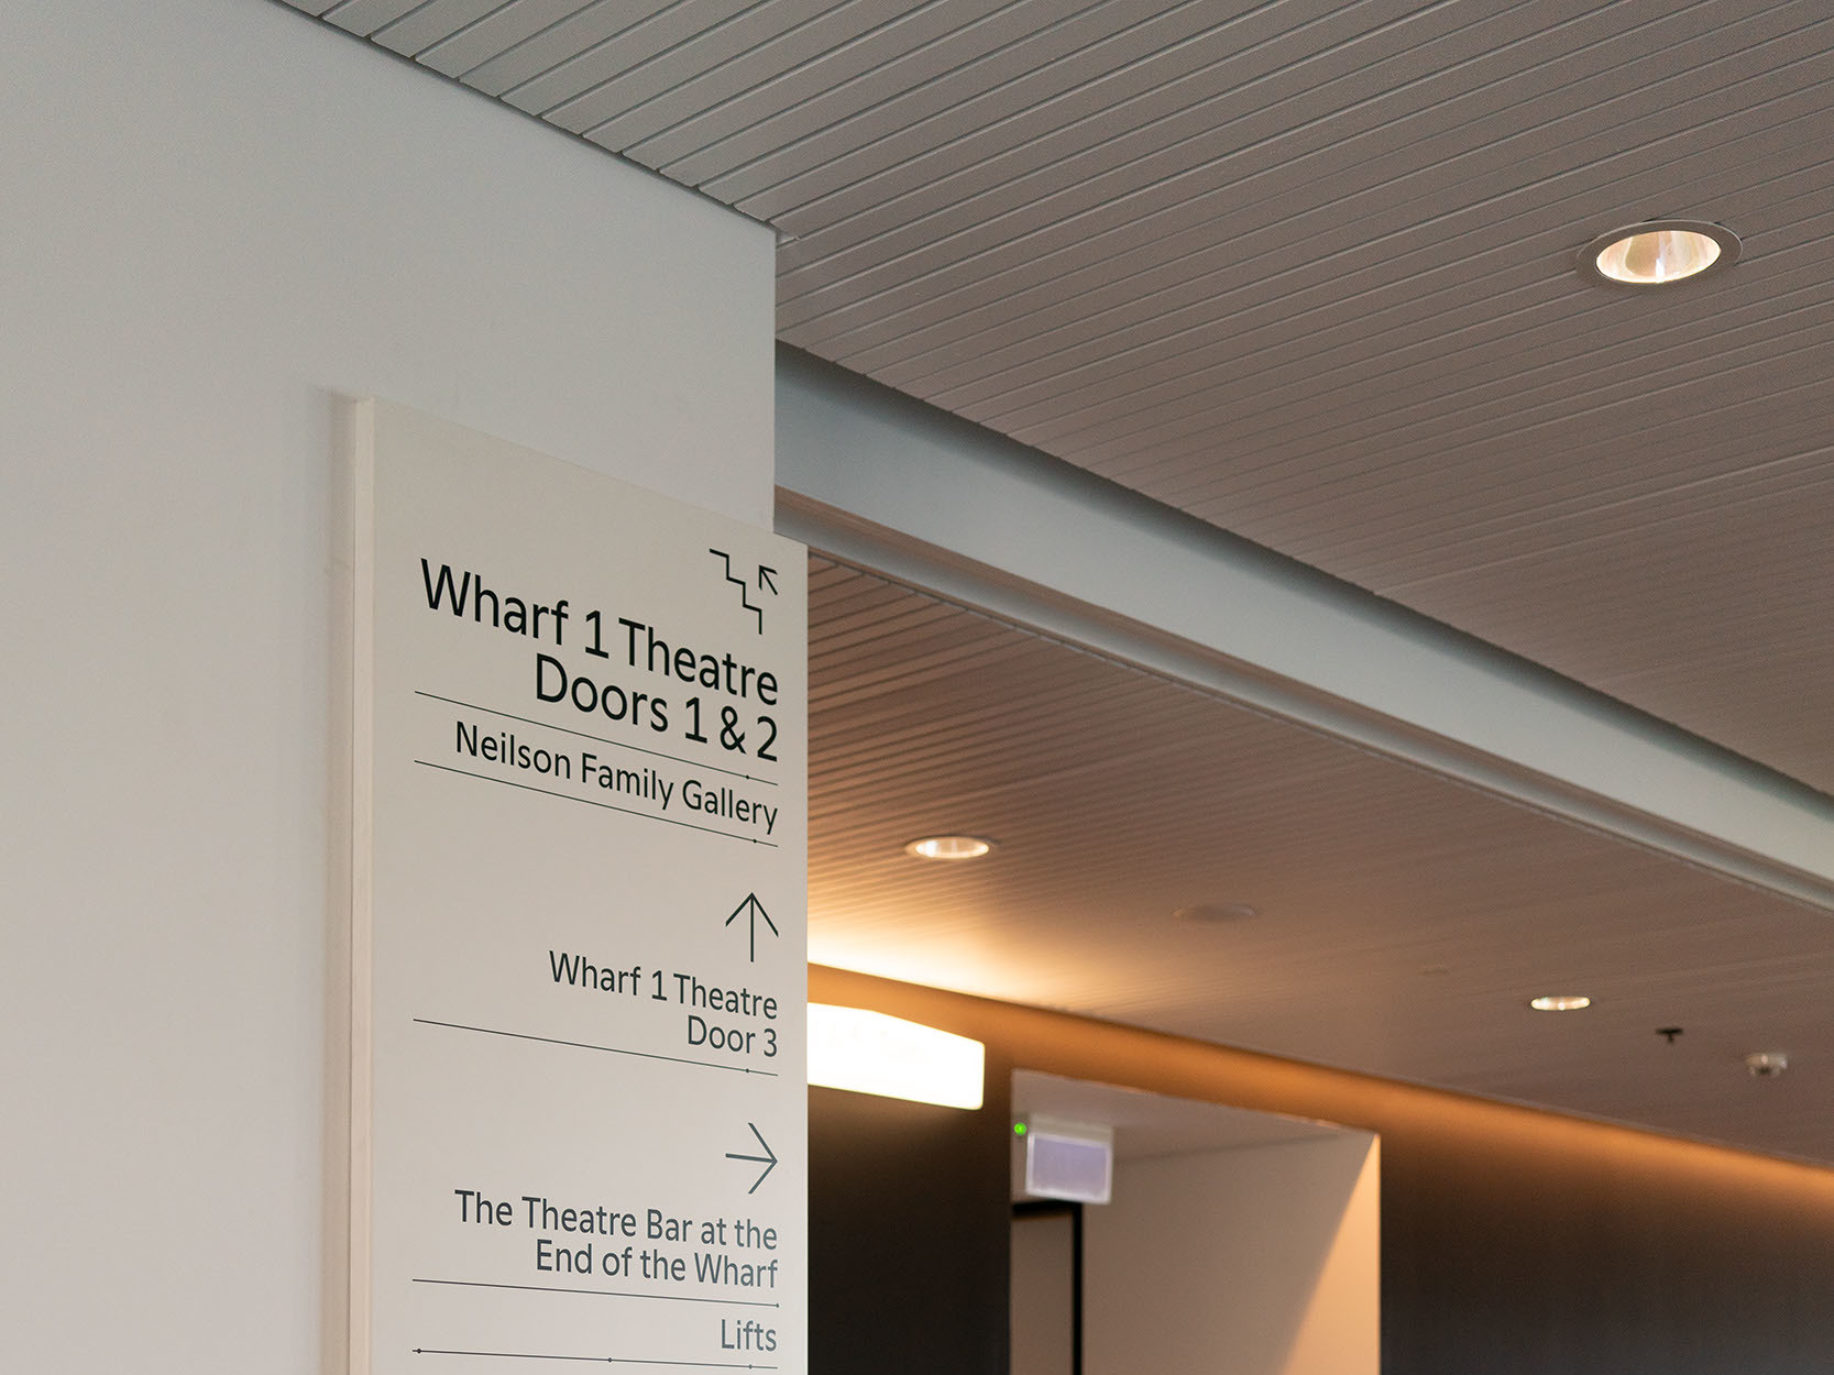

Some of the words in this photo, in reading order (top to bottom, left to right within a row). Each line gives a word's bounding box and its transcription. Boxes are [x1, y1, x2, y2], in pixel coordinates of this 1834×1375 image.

[420, 557, 569, 646] Wharf
[584, 609, 610, 660] 1
[618, 616, 779, 706] Theatre
[536, 652, 669, 733] Doors
[684, 696, 708, 745] 1
[719, 705, 747, 755] &
[756, 715, 778, 763] 2
[456, 720, 571, 780] Neilson
[581, 751, 675, 811] Family
[682, 779, 779, 836] Gallery
[548, 949, 642, 997] Wharf
[651, 969, 668, 1002] 1
[672, 972, 778, 1020] Theatre
[687, 1014, 757, 1054] Door
[763, 1027, 778, 1058] 3
[454, 1189, 513, 1227] The
[521, 1195, 637, 1238] Theatre
[647, 1208, 693, 1243] Bar
[700, 1217, 727, 1246] at
[733, 1218, 778, 1251] the
[536, 1238, 593, 1275] End
[601, 1246, 633, 1278] of
[639, 1248, 686, 1282] the
[693, 1252, 779, 1289] Wharf
[721, 1318, 777, 1352] Lifts
